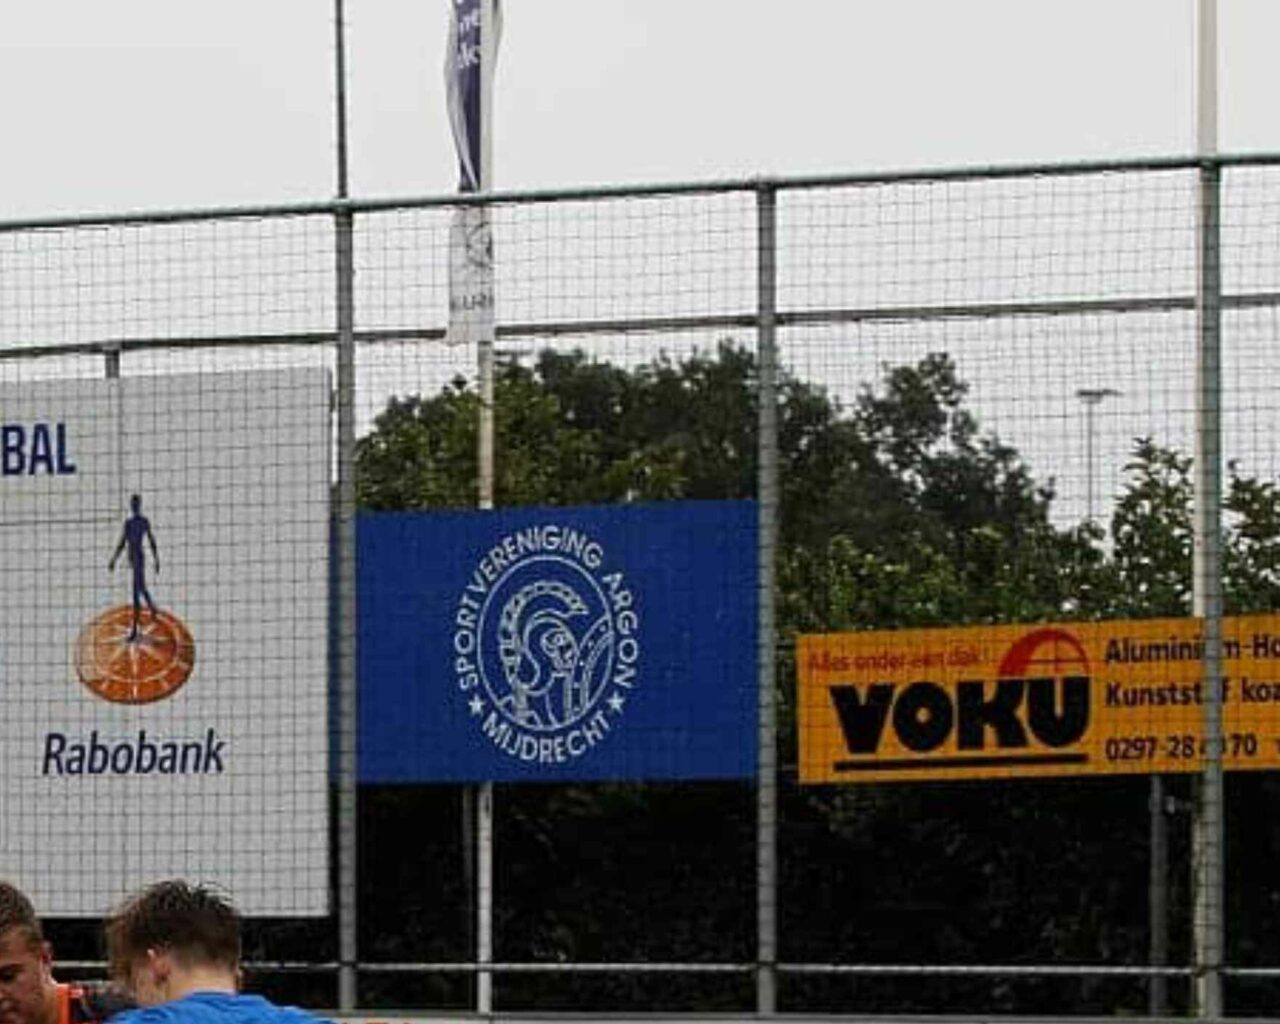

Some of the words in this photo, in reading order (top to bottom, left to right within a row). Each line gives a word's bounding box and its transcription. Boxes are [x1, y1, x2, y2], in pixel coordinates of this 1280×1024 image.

[603, 572, 638, 688] ARGON
[1106, 634, 1280, 662] Aluminim-Ho
[829, 676, 1091, 754] VOKU
[1107, 677, 1229, 706] Kunststf
[42, 727, 226, 776] Rabobank
[482, 711, 610, 762] MIJDRECHT
[1106, 736, 1157, 761] 0297
